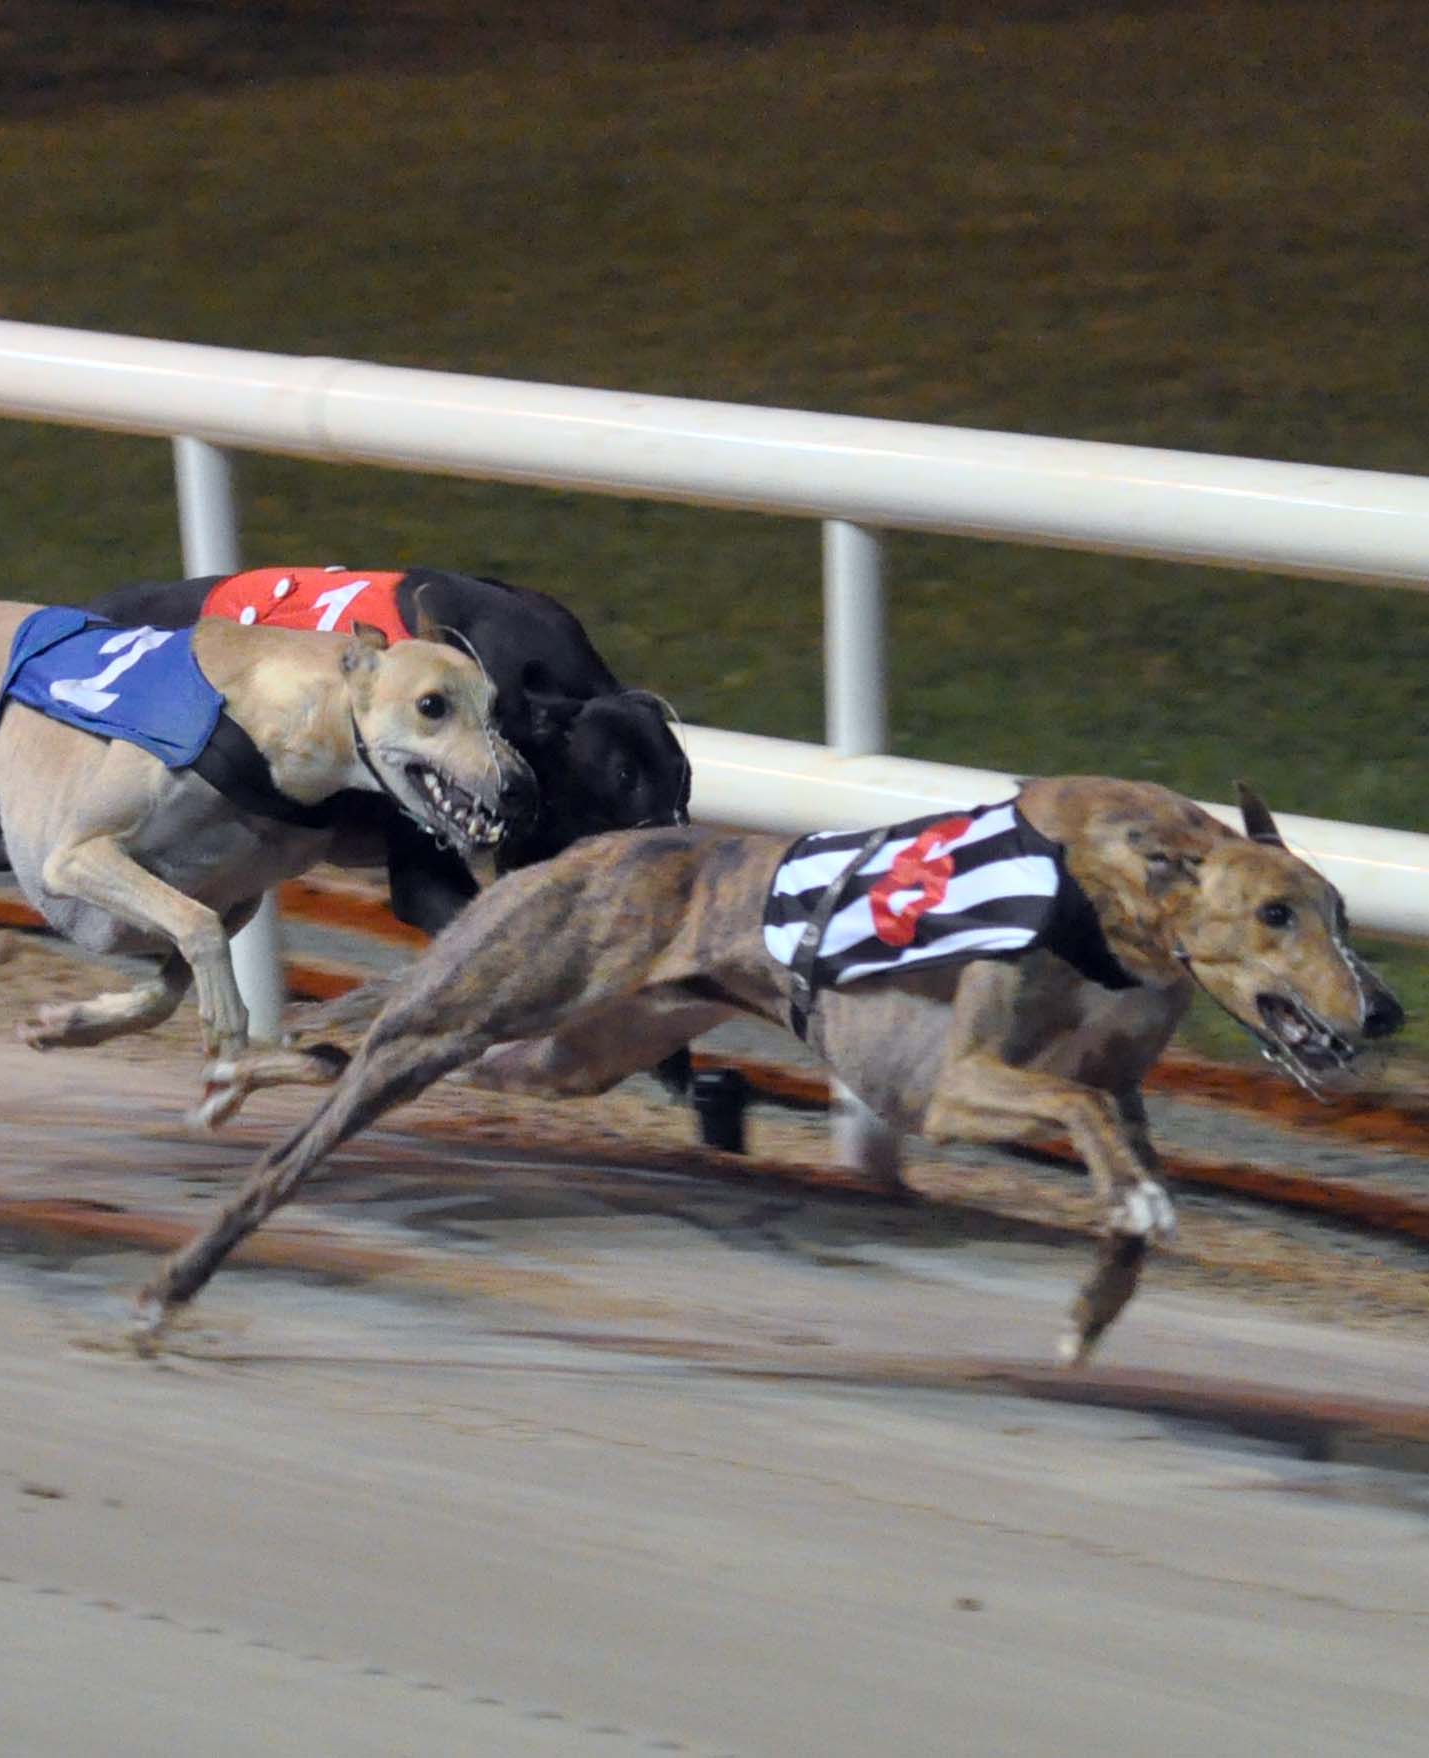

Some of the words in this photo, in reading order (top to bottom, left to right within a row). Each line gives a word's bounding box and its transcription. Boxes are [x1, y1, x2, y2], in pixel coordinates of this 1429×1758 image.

[312, 580, 371, 631] 1
[50, 624, 174, 713] 2
[870, 817, 972, 946] 6
